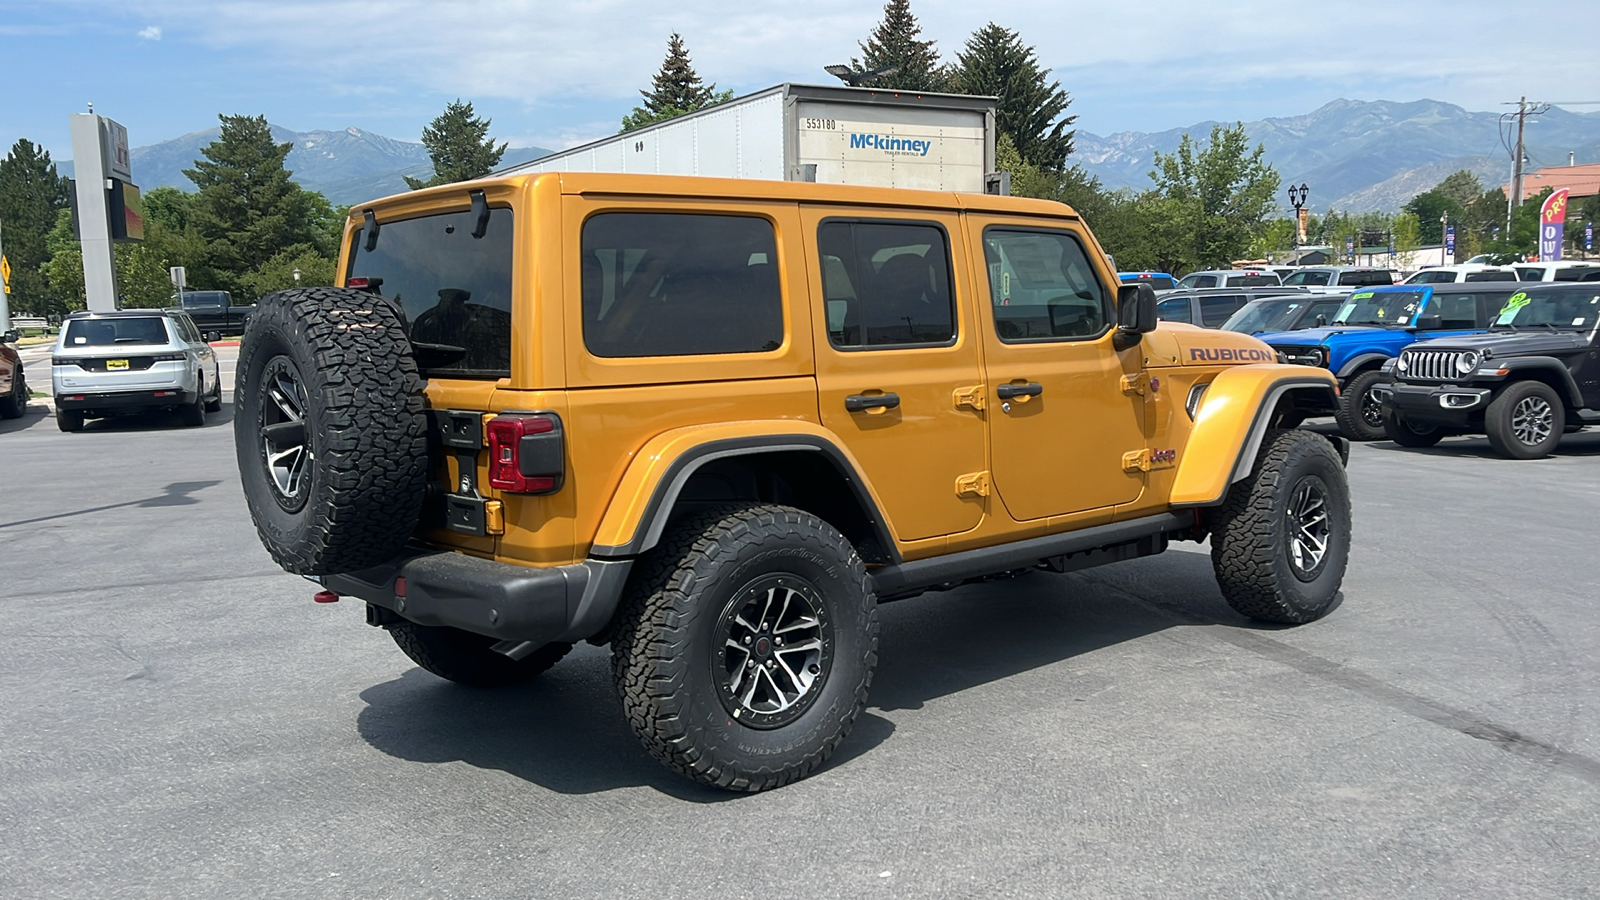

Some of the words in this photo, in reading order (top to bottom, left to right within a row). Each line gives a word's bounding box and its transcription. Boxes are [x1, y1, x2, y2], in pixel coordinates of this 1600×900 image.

[806, 118, 836, 130] 553180
[1545, 194, 1565, 222] PRE
[1189, 348, 1273, 361] RUBICON
[1150, 447, 1176, 465] Jeep
